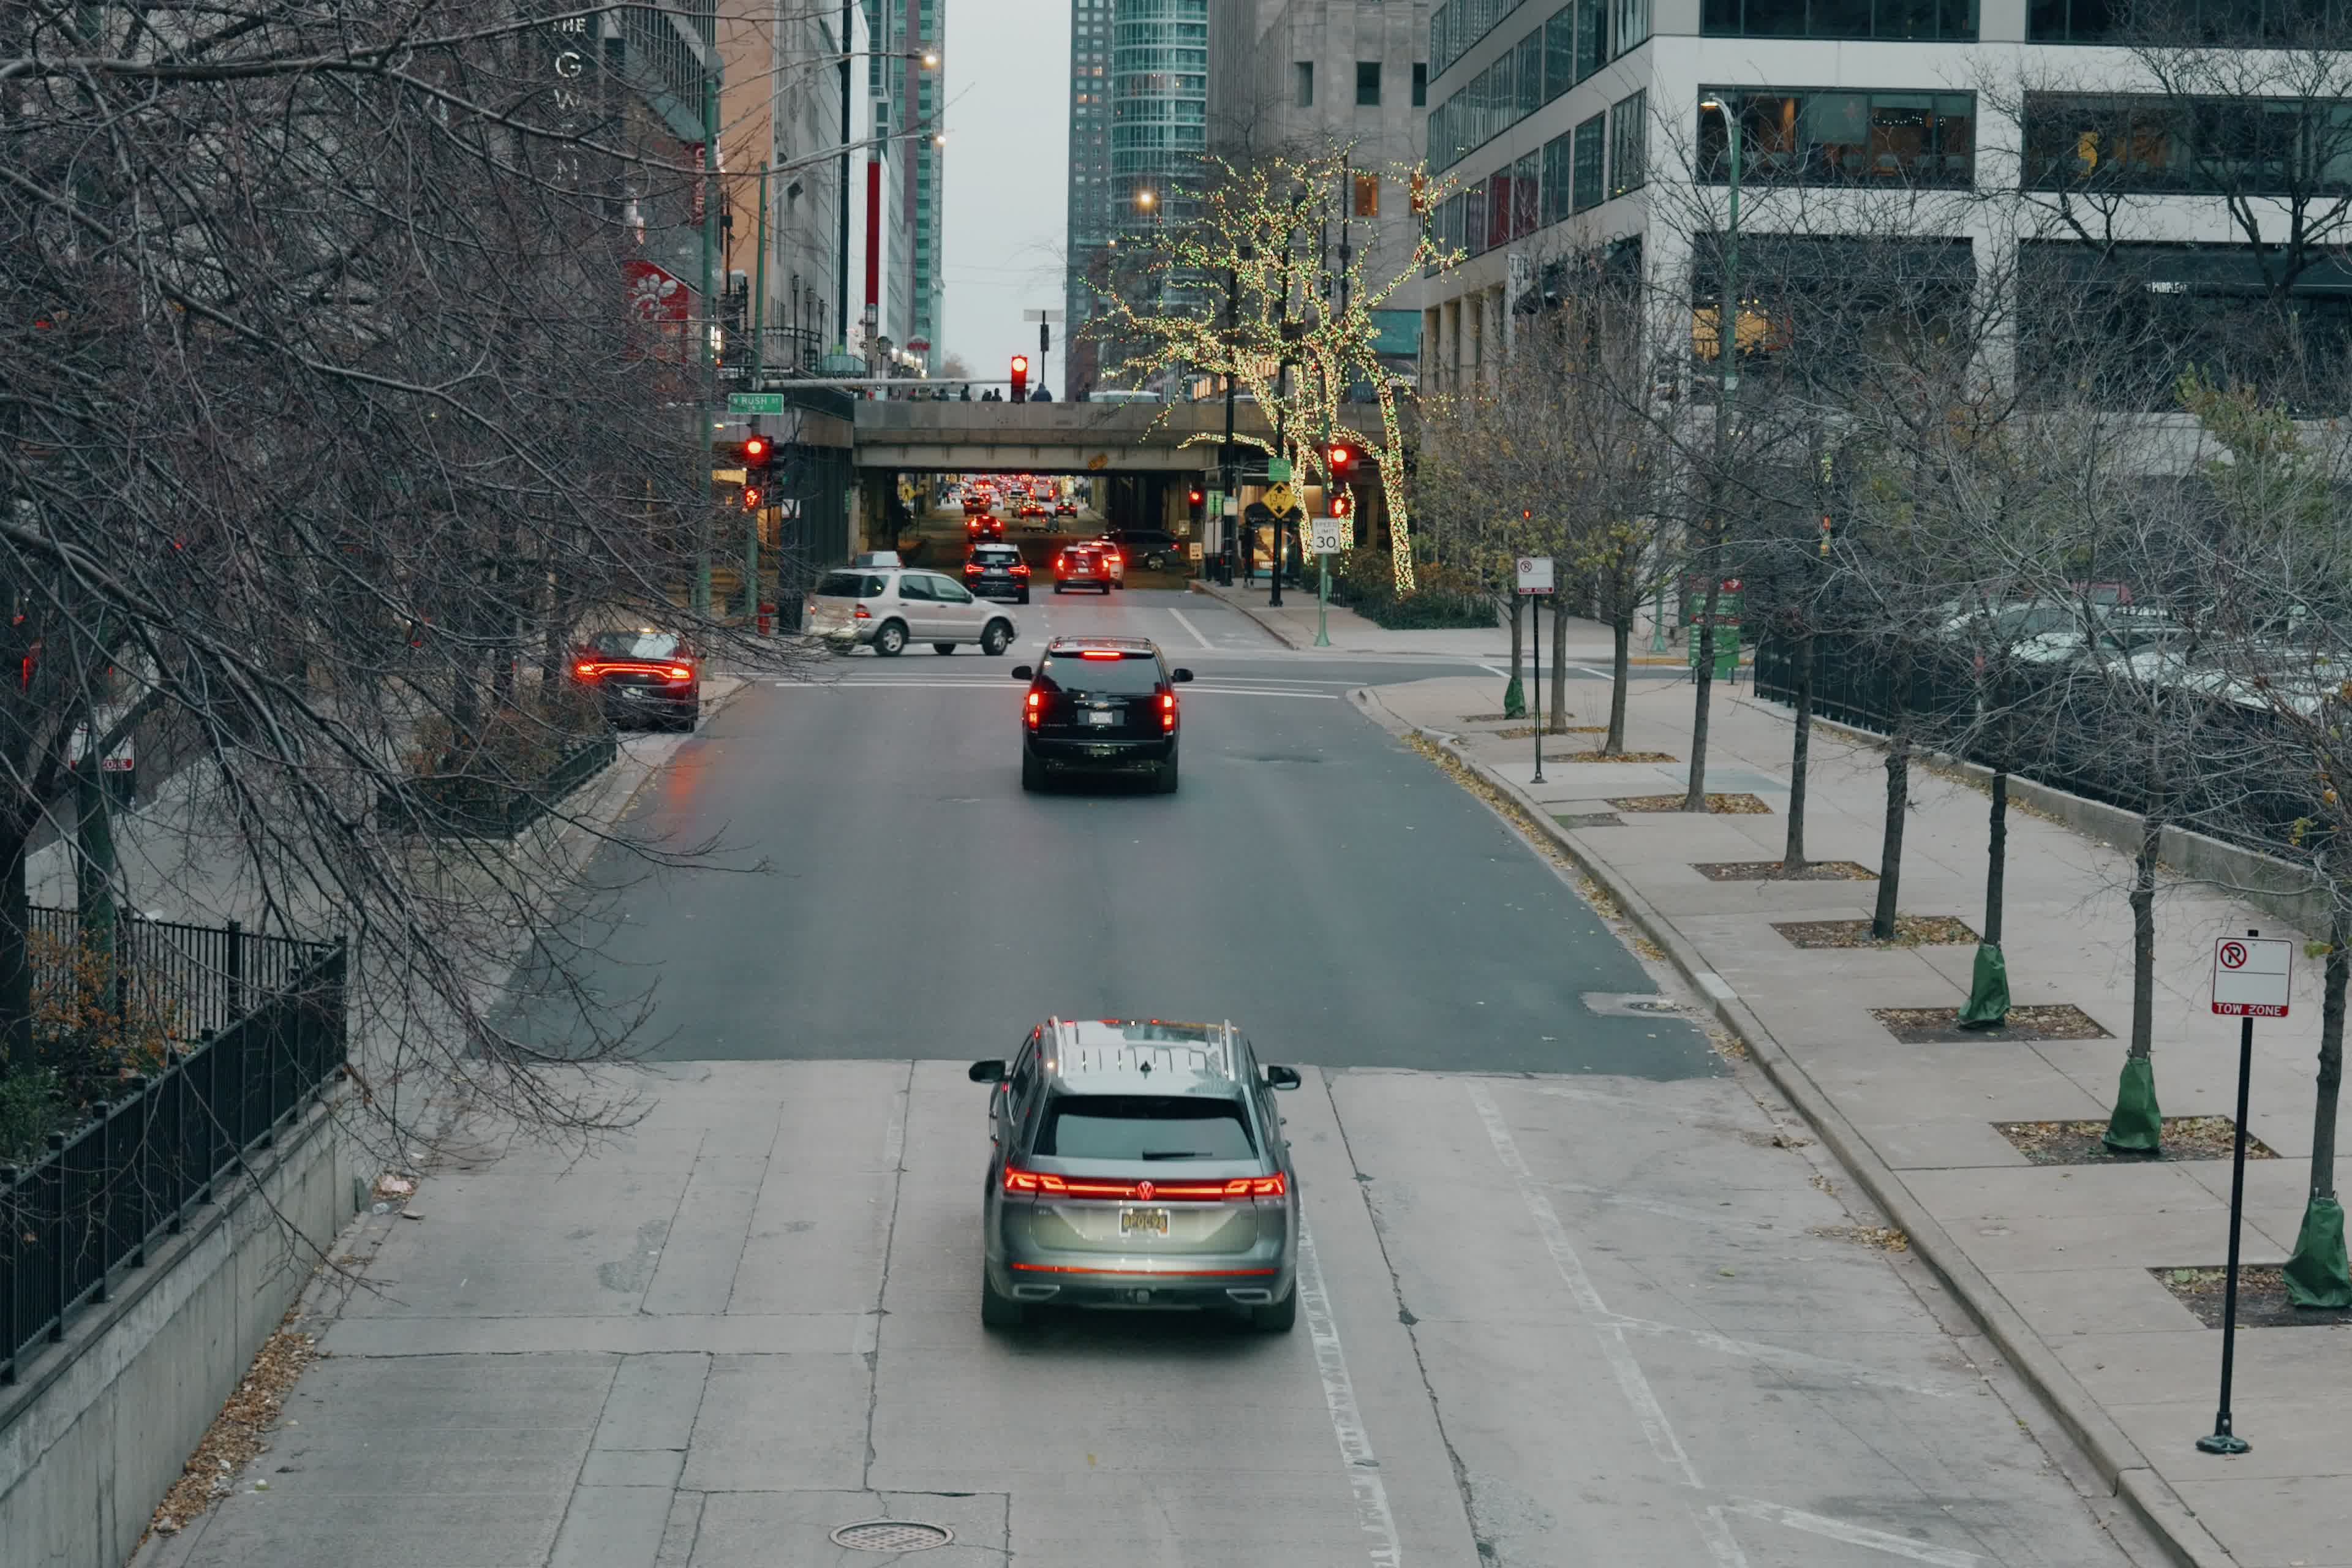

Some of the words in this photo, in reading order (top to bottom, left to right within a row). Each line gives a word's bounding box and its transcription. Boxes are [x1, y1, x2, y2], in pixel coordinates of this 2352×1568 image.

[741, 396, 767, 405] RUSH
[1316, 536, 1336, 548] 30
[2217, 1003, 2242, 1014] TOW
[2248, 1005, 2282, 1016] ZONE
